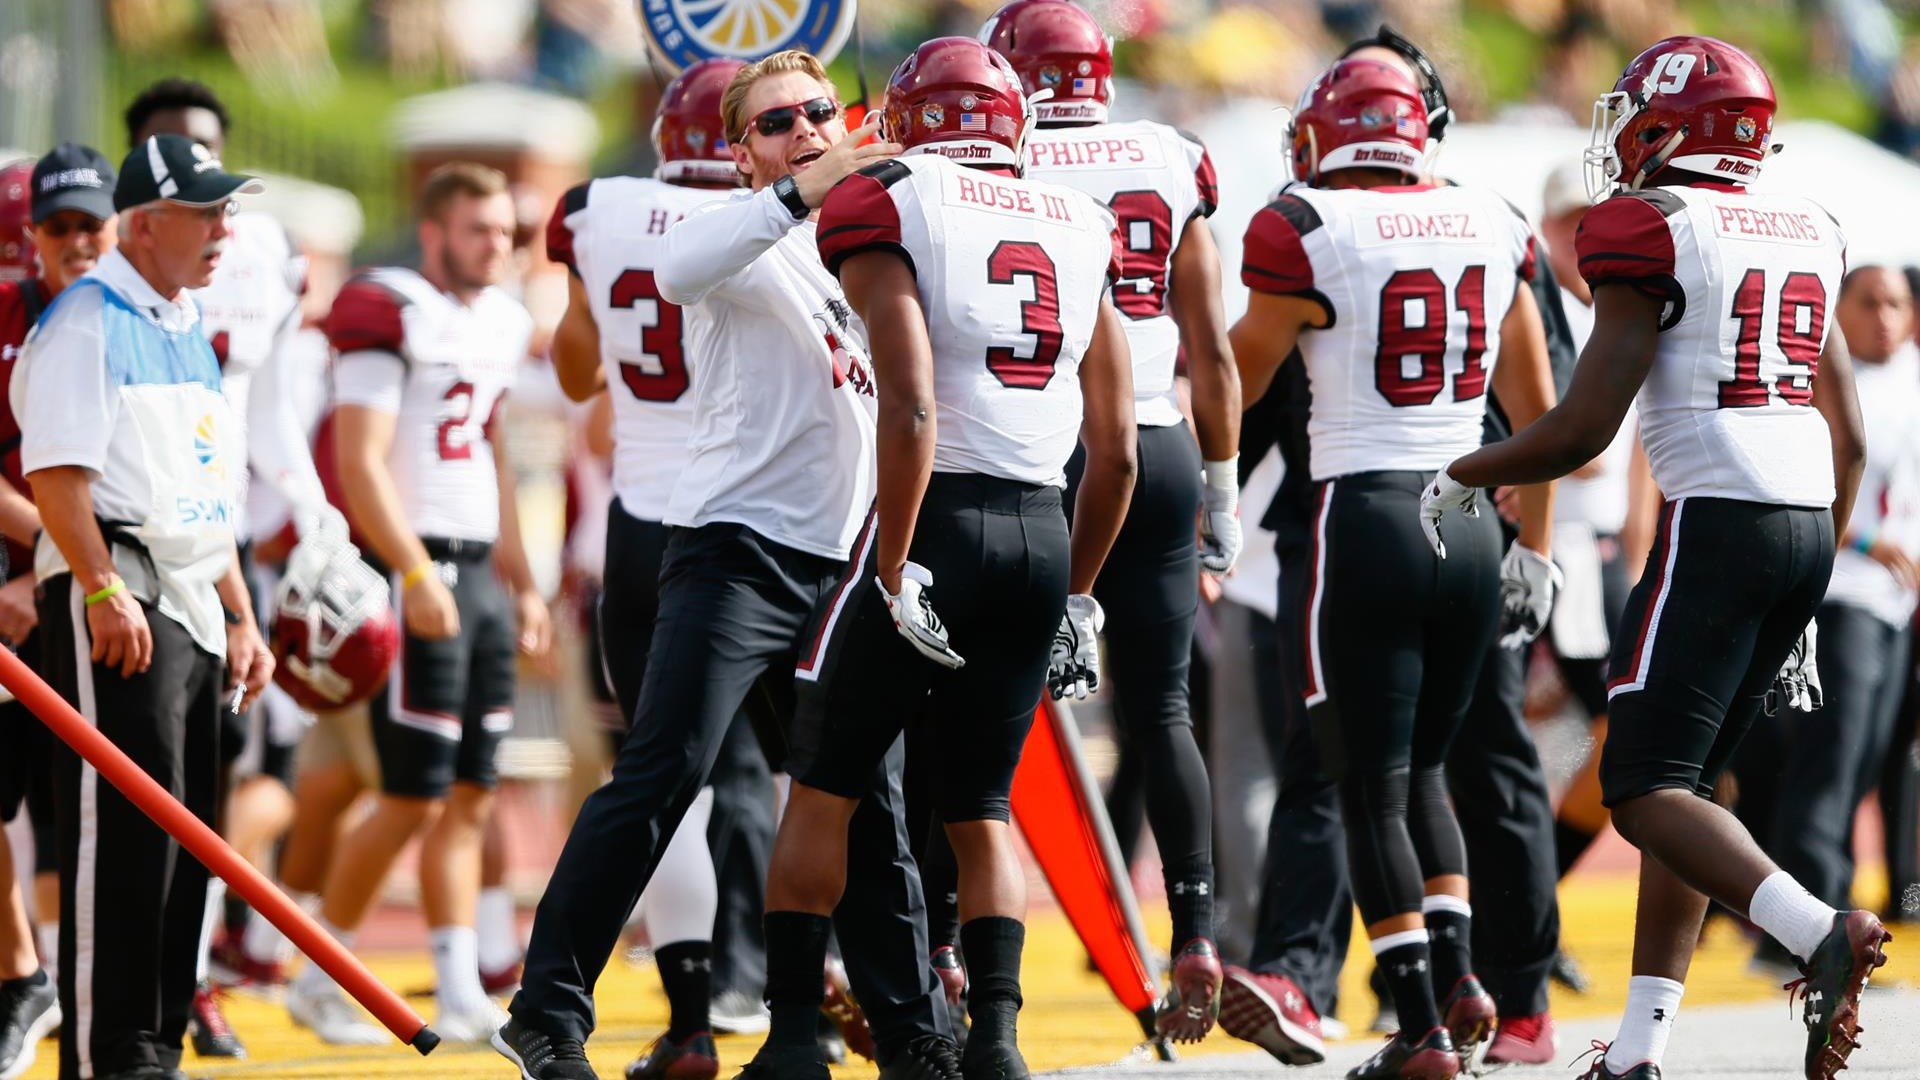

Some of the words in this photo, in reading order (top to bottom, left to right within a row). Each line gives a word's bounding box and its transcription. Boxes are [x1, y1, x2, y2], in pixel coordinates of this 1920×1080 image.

[1642, 53, 1697, 96] 19
[1029, 139, 1145, 167] PHIPPS
[957, 175, 1035, 213] ROSE
[1040, 192, 1072, 222] III
[1376, 213, 1477, 240] GOMEZ
[1715, 205, 1820, 242] PERKINS
[985, 240, 1064, 391] 3
[1374, 264, 1488, 408] 81
[1718, 268, 1827, 409] 19
